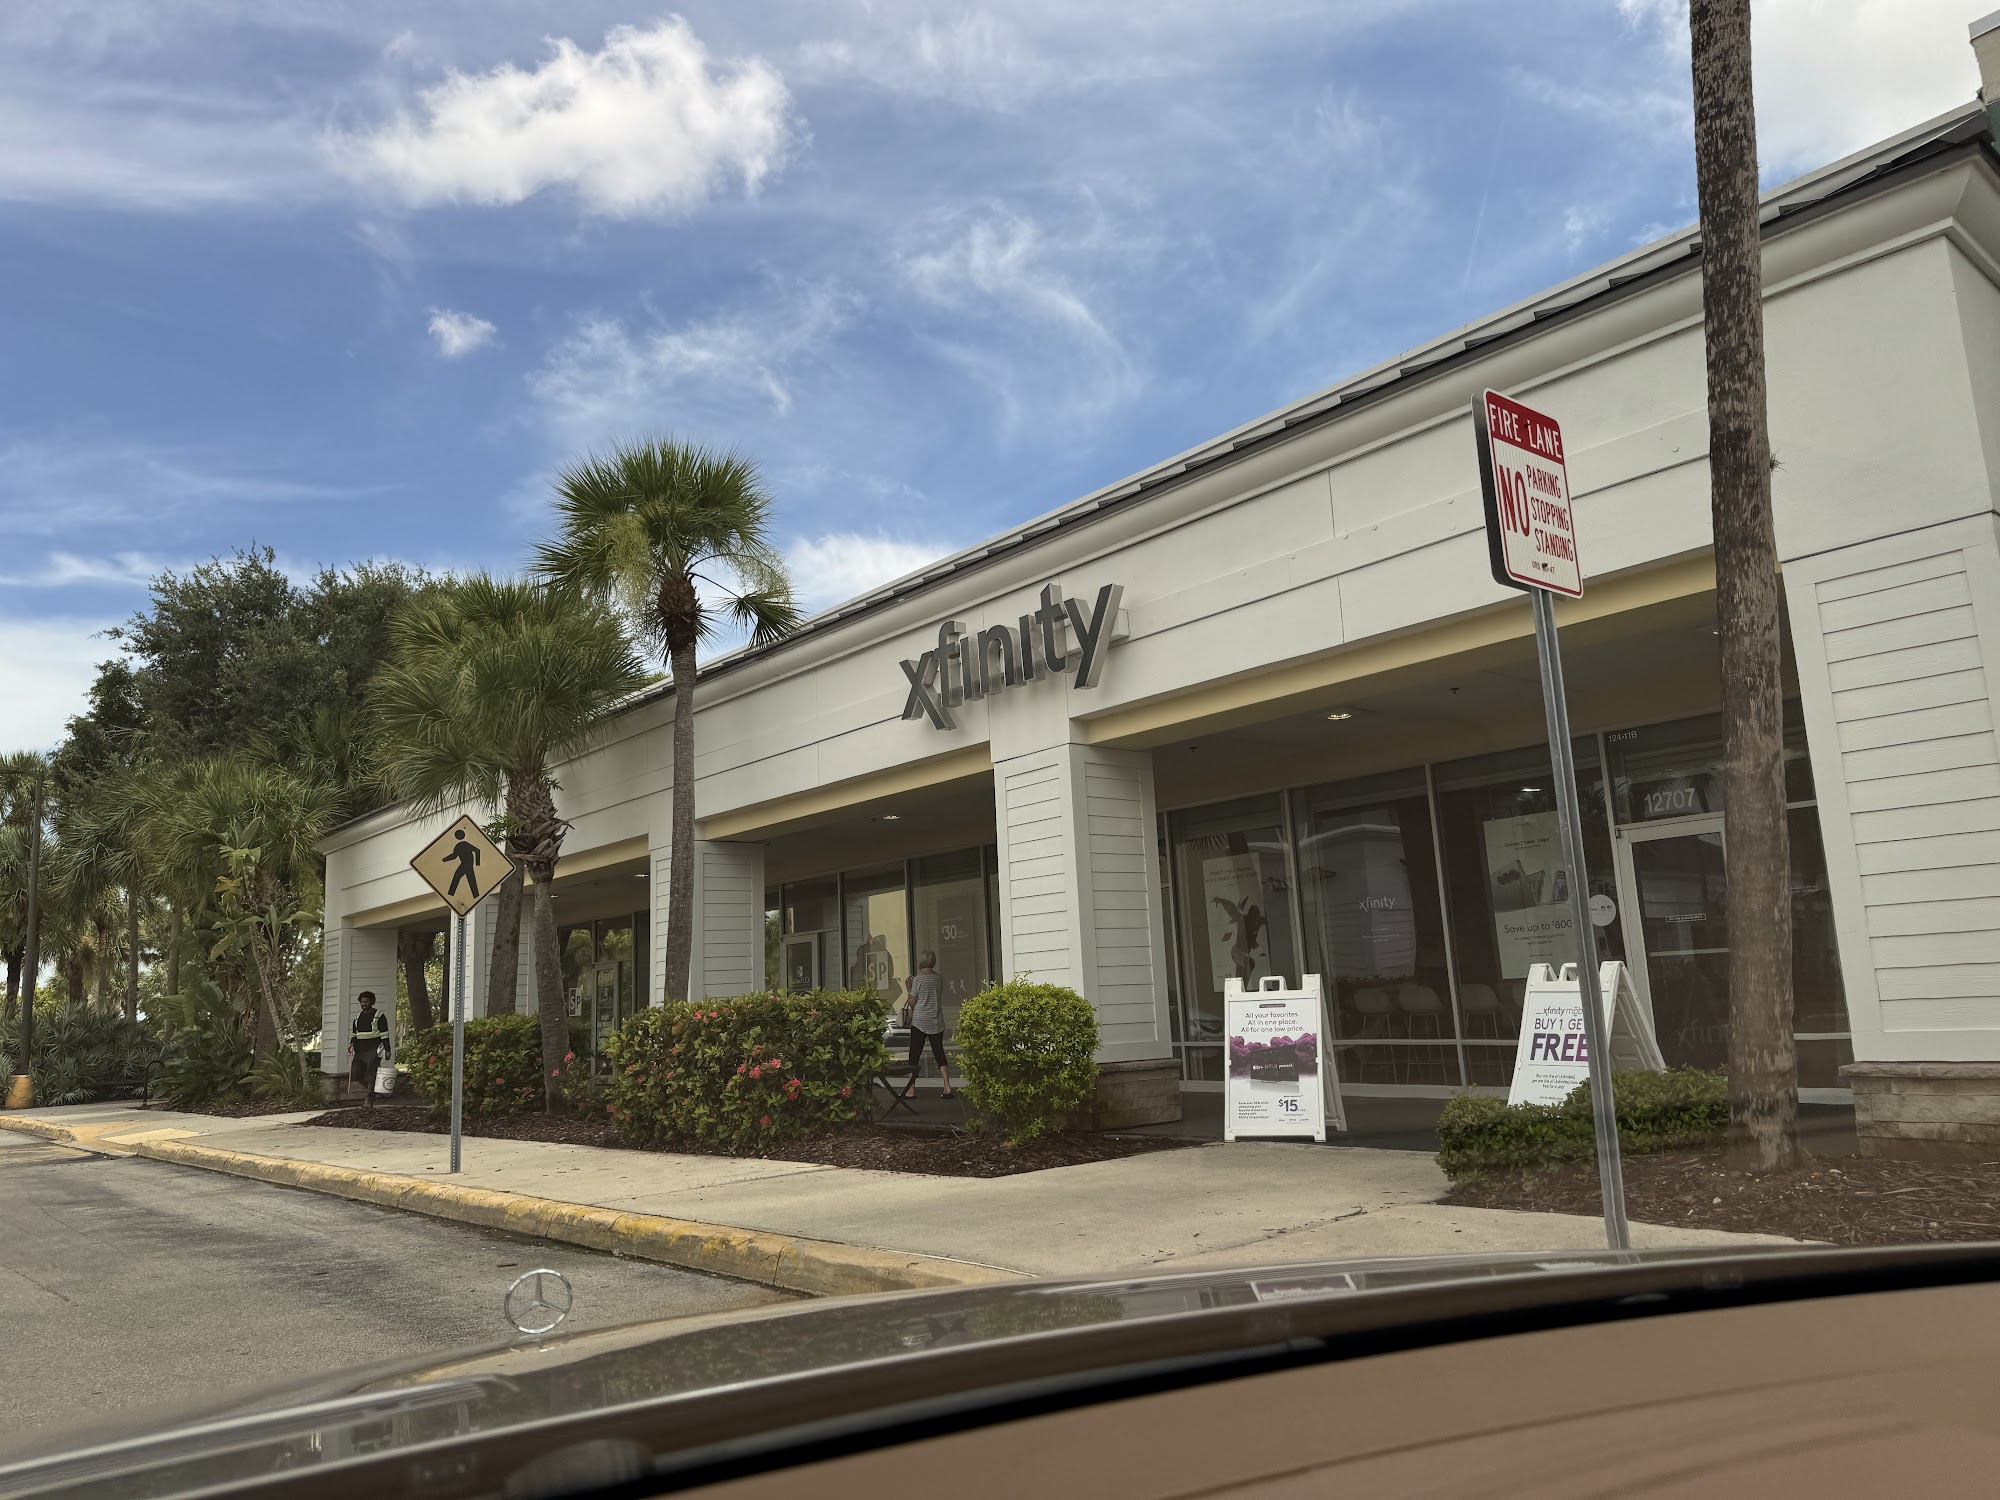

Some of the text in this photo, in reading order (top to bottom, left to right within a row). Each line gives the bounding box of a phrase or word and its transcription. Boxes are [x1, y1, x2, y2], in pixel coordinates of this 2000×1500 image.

[1489, 403, 1562, 459] FIRE LANE
[1526, 464, 1562, 499] PARKING
[1499, 464, 1530, 537] NO
[1531, 496, 1570, 531] STOPPING
[1534, 528, 1574, 562] STANDING
[899, 583, 1124, 731] xfinity
[1608, 731, 1638, 742] 124-11B
[1644, 787, 1695, 813] 12707
[1359, 896, 1395, 912] xfinity
[941, 924, 957, 940] $30
[1504, 919, 1573, 934] Save up to $800
[1534, 1018, 1557, 1030] BUY
[1568, 1019, 1584, 1030] GE
[1543, 1006, 1566, 1017] xfinity
[1530, 1033, 1588, 1062] FREE
[1278, 1099, 1298, 1112] $15
